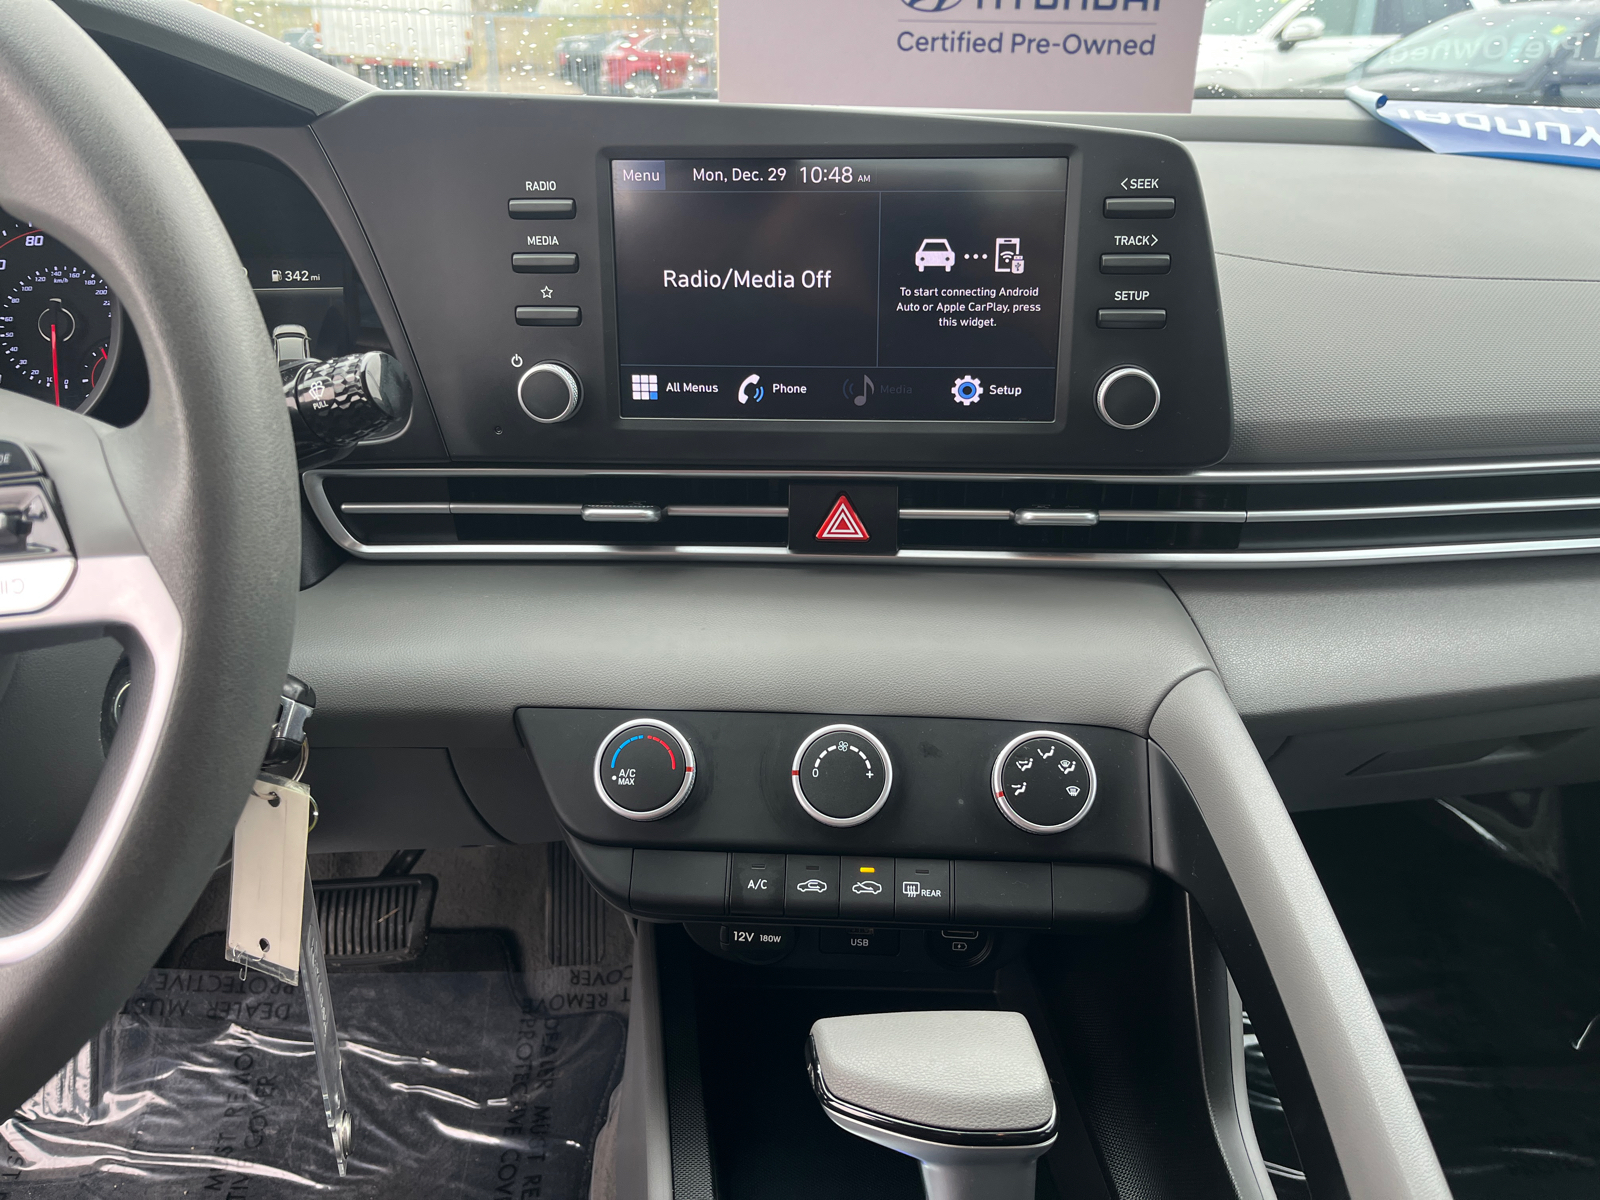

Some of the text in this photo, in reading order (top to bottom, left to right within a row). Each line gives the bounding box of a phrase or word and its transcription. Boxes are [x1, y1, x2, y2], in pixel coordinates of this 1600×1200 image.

[896, 31, 1156, 56] Certified Pre-Owned
[622, 166, 871, 184] Menu Mon, Dec. 29 10:48 AM
[525, 180, 557, 191] RADIO
[1129, 178, 1159, 189] SEEK
[25, 235, 44, 247] 80
[527, 235, 559, 246] MEDIA
[1114, 235, 1150, 246] TRACK
[285, 270, 321, 282] 342 mi
[663, 268, 832, 290] Radio/Media Off
[900, 286, 1039, 298] To start connecting Android
[1114, 290, 1150, 301] SETUP
[896, 302, 1041, 313] Auto or Apple CarPlay, press
[938, 317, 997, 328] this widget.
[665, 382, 719, 393] All Menus
[772, 383, 807, 394] Phone
[880, 384, 913, 394] Media
[989, 384, 1022, 397] Setup
[312, 401, 329, 411] PULL
[618, 768, 636, 778] A/C
[811, 768, 818, 778] 0
[618, 777, 635, 786] MAX
[747, 878, 768, 891] A/C
[921, 888, 942, 898] REAR
[733, 931, 782, 944] 12V 180W
[850, 937, 869, 947] USB
[155, 972, 296, 995] PROTECTIVE
[207, 1001, 291, 1021] DEALER
[243, 1074, 278, 1149] COVER
[494, 1149, 521, 1200] COV
